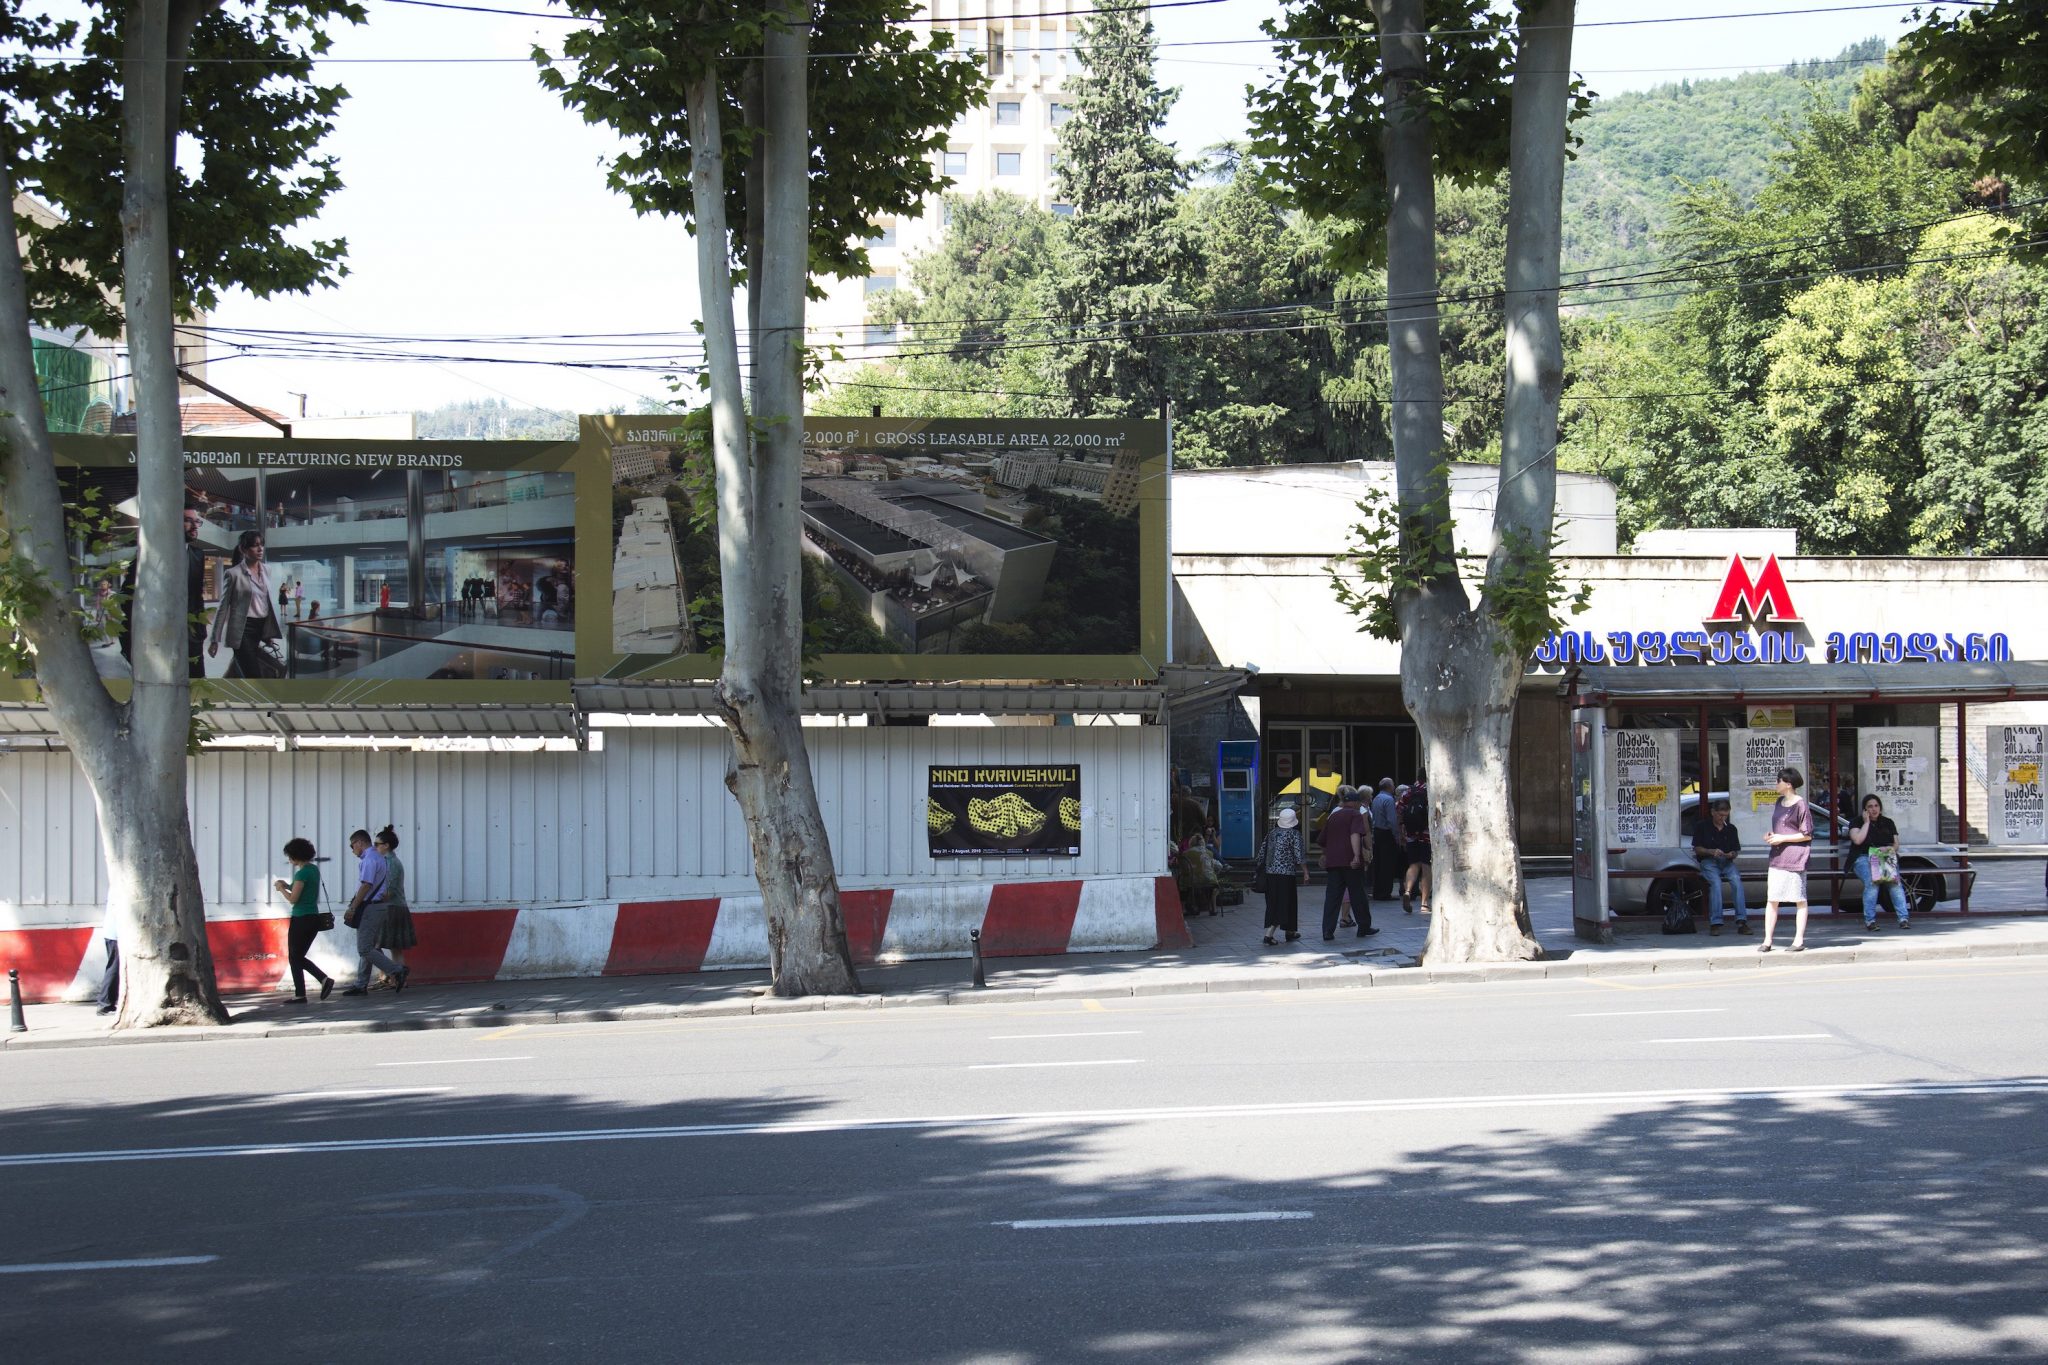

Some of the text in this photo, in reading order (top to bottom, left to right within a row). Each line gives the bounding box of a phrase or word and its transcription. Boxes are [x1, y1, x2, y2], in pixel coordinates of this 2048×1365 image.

[803, 431, 842, 445] 2,000
[874, 432, 925, 445] GROSS
[929, 432, 1005, 446] LEASABLE
[1008, 433, 1049, 446] AREA
[1053, 433, 1101, 448] 22,000
[183, 451, 241, 465] რენდები
[257, 452, 463, 467] FEATURING NEW BRANDS
[1536, 629, 2010, 664] ვისუფლების მოედანი
[932, 769, 1076, 782] NINO KVRIVISHVILI
